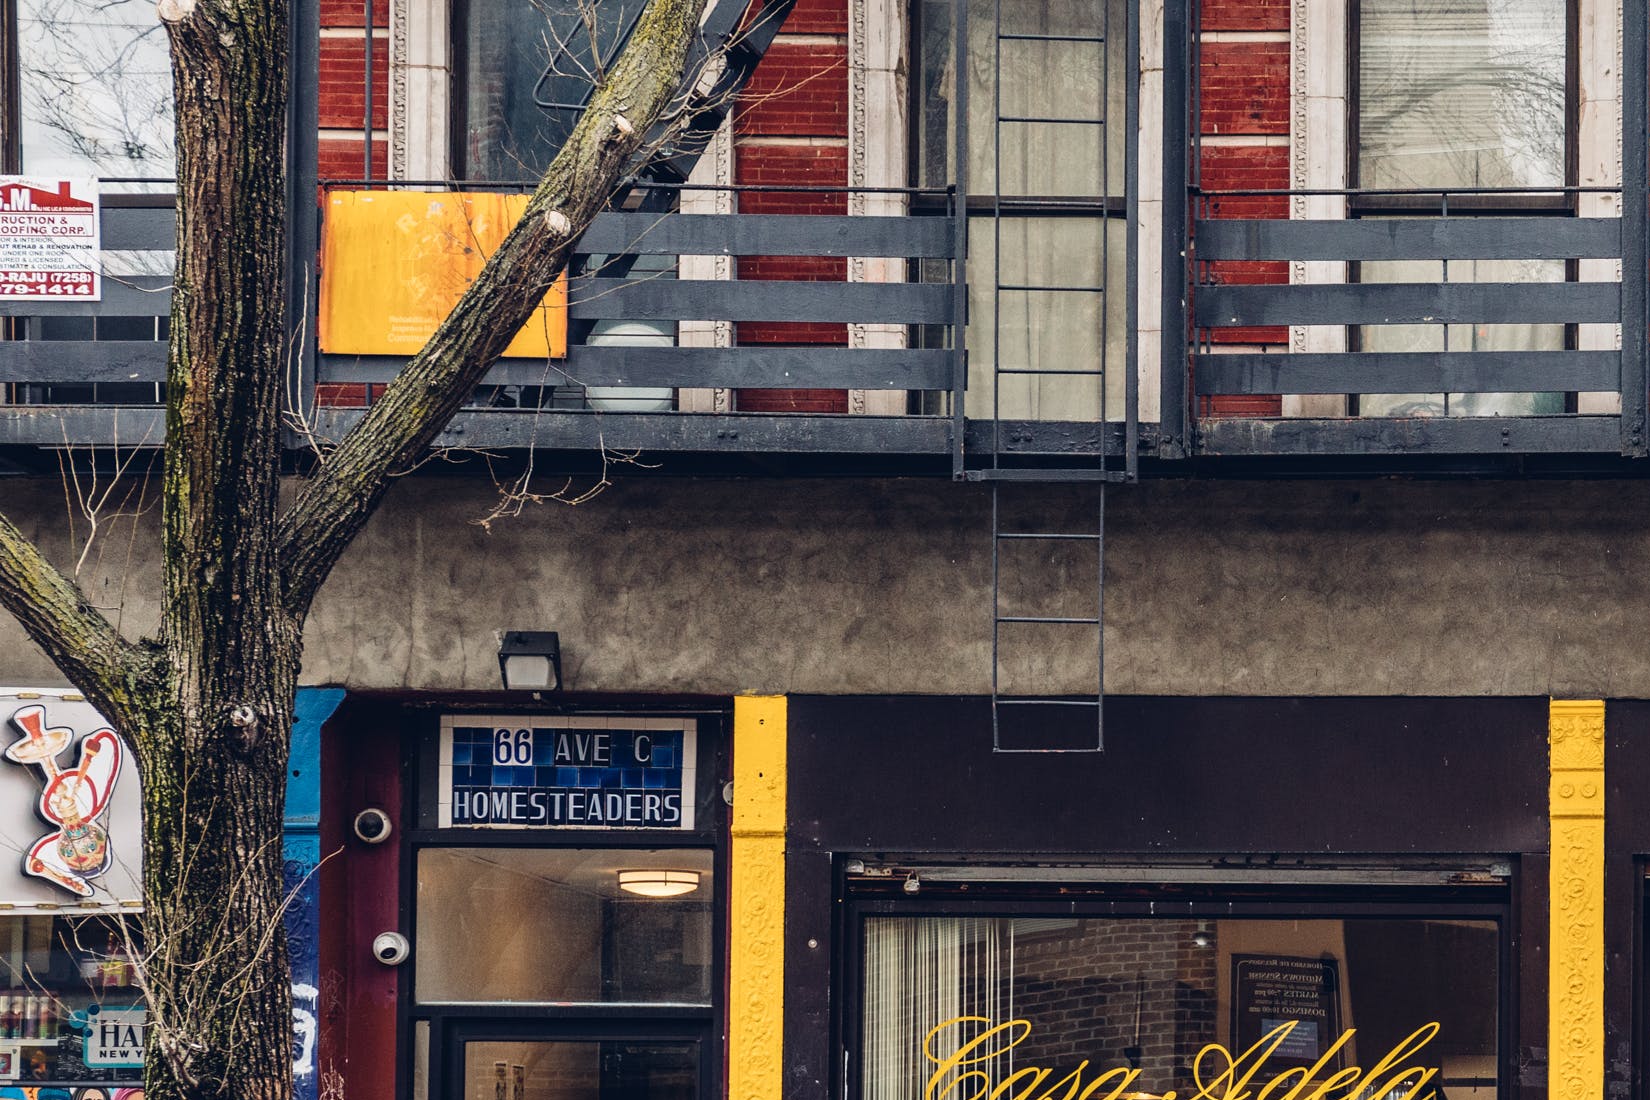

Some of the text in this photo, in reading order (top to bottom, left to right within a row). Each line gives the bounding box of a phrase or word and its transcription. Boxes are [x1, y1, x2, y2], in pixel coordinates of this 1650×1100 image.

[60, 216, 68, 225] &
[0, 226, 86, 235] OOFING CORP.
[50, 273, 92, 283] (7258)
[0, 283, 90, 295] 79-1414
[493, 728, 650, 765] 66 AVE C
[453, 791, 680, 822] HOMESTEADERS
[100, 1020, 145, 1047] HA
[100, 1050, 130, 1058] NEW
